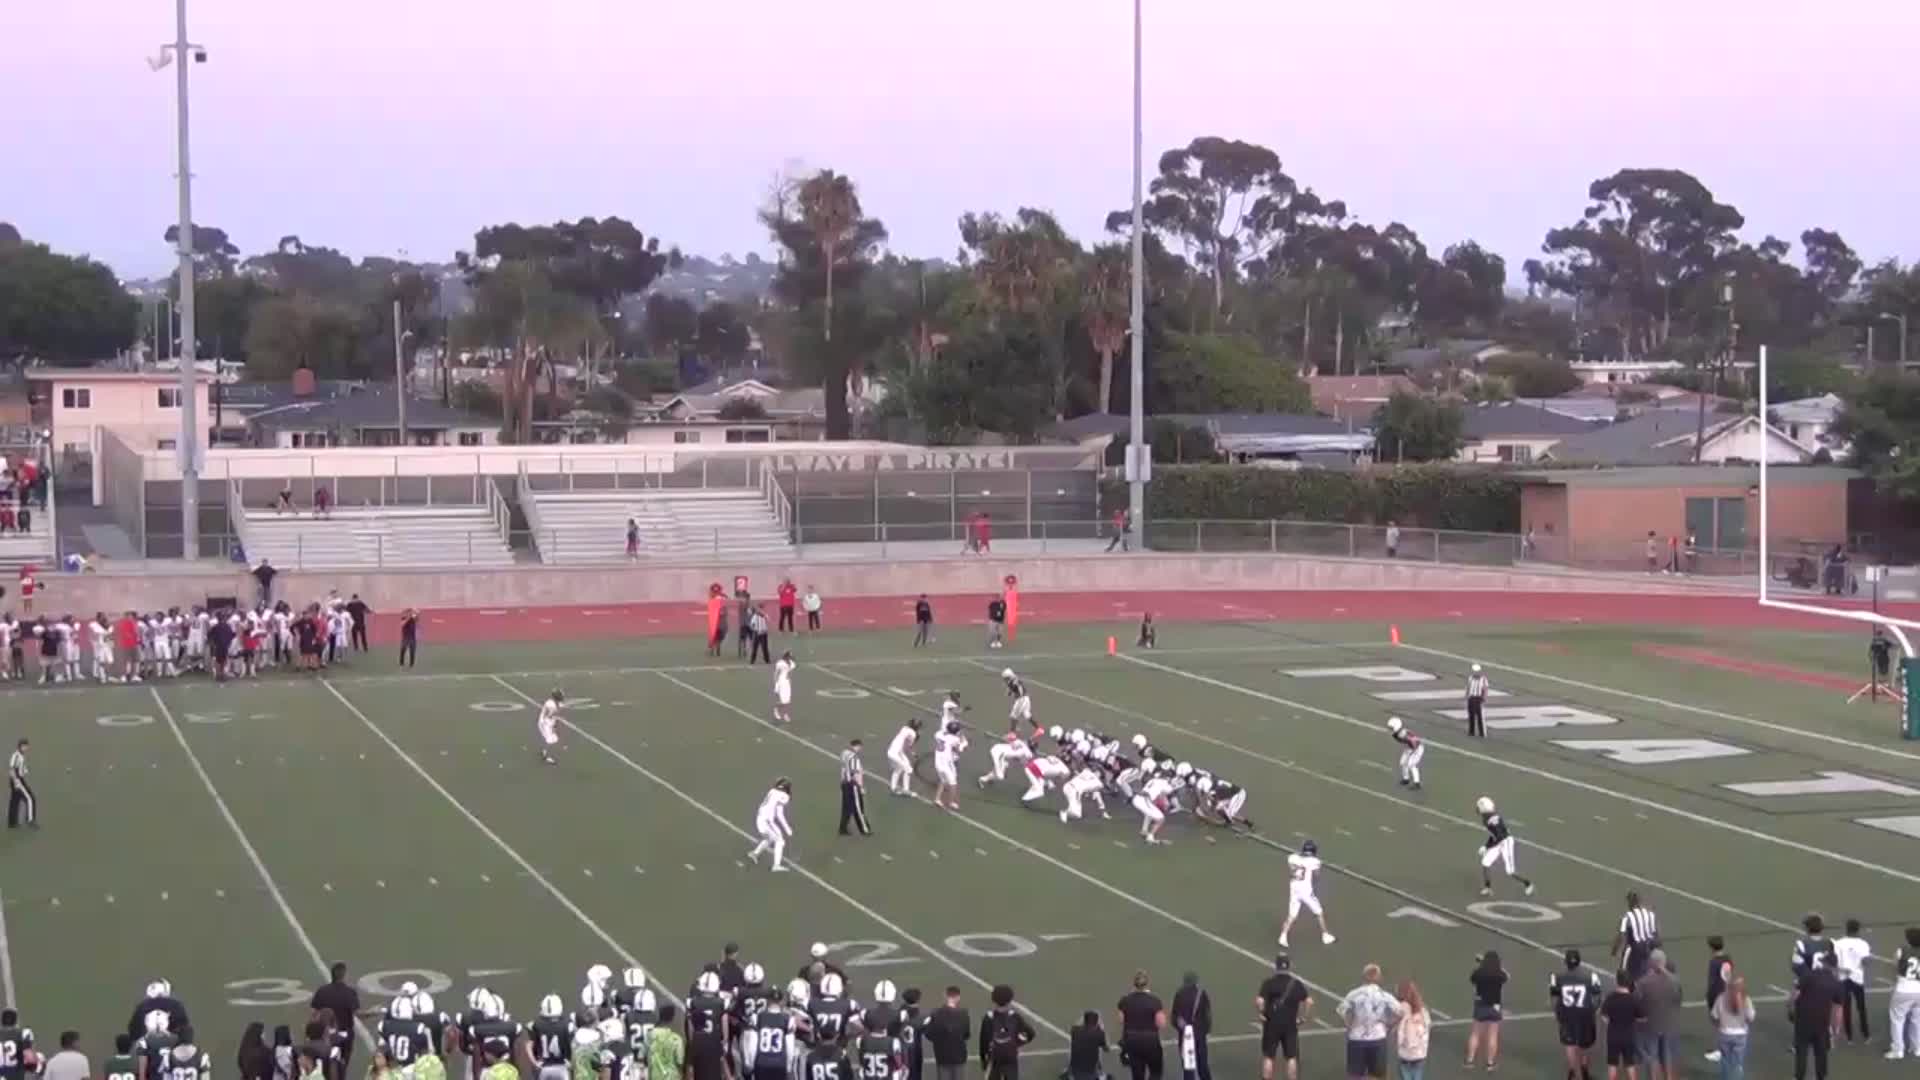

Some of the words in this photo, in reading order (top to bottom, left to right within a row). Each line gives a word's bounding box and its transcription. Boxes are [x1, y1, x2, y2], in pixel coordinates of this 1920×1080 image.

[826, 933, 1038, 967] 20
[1562, 984, 1587, 1009] 57
[388, 1034, 410, 1061] 10
[541, 1034, 560, 1059] 14
[759, 1027, 784, 1053] 83
[863, 1053, 888, 1078] 35
